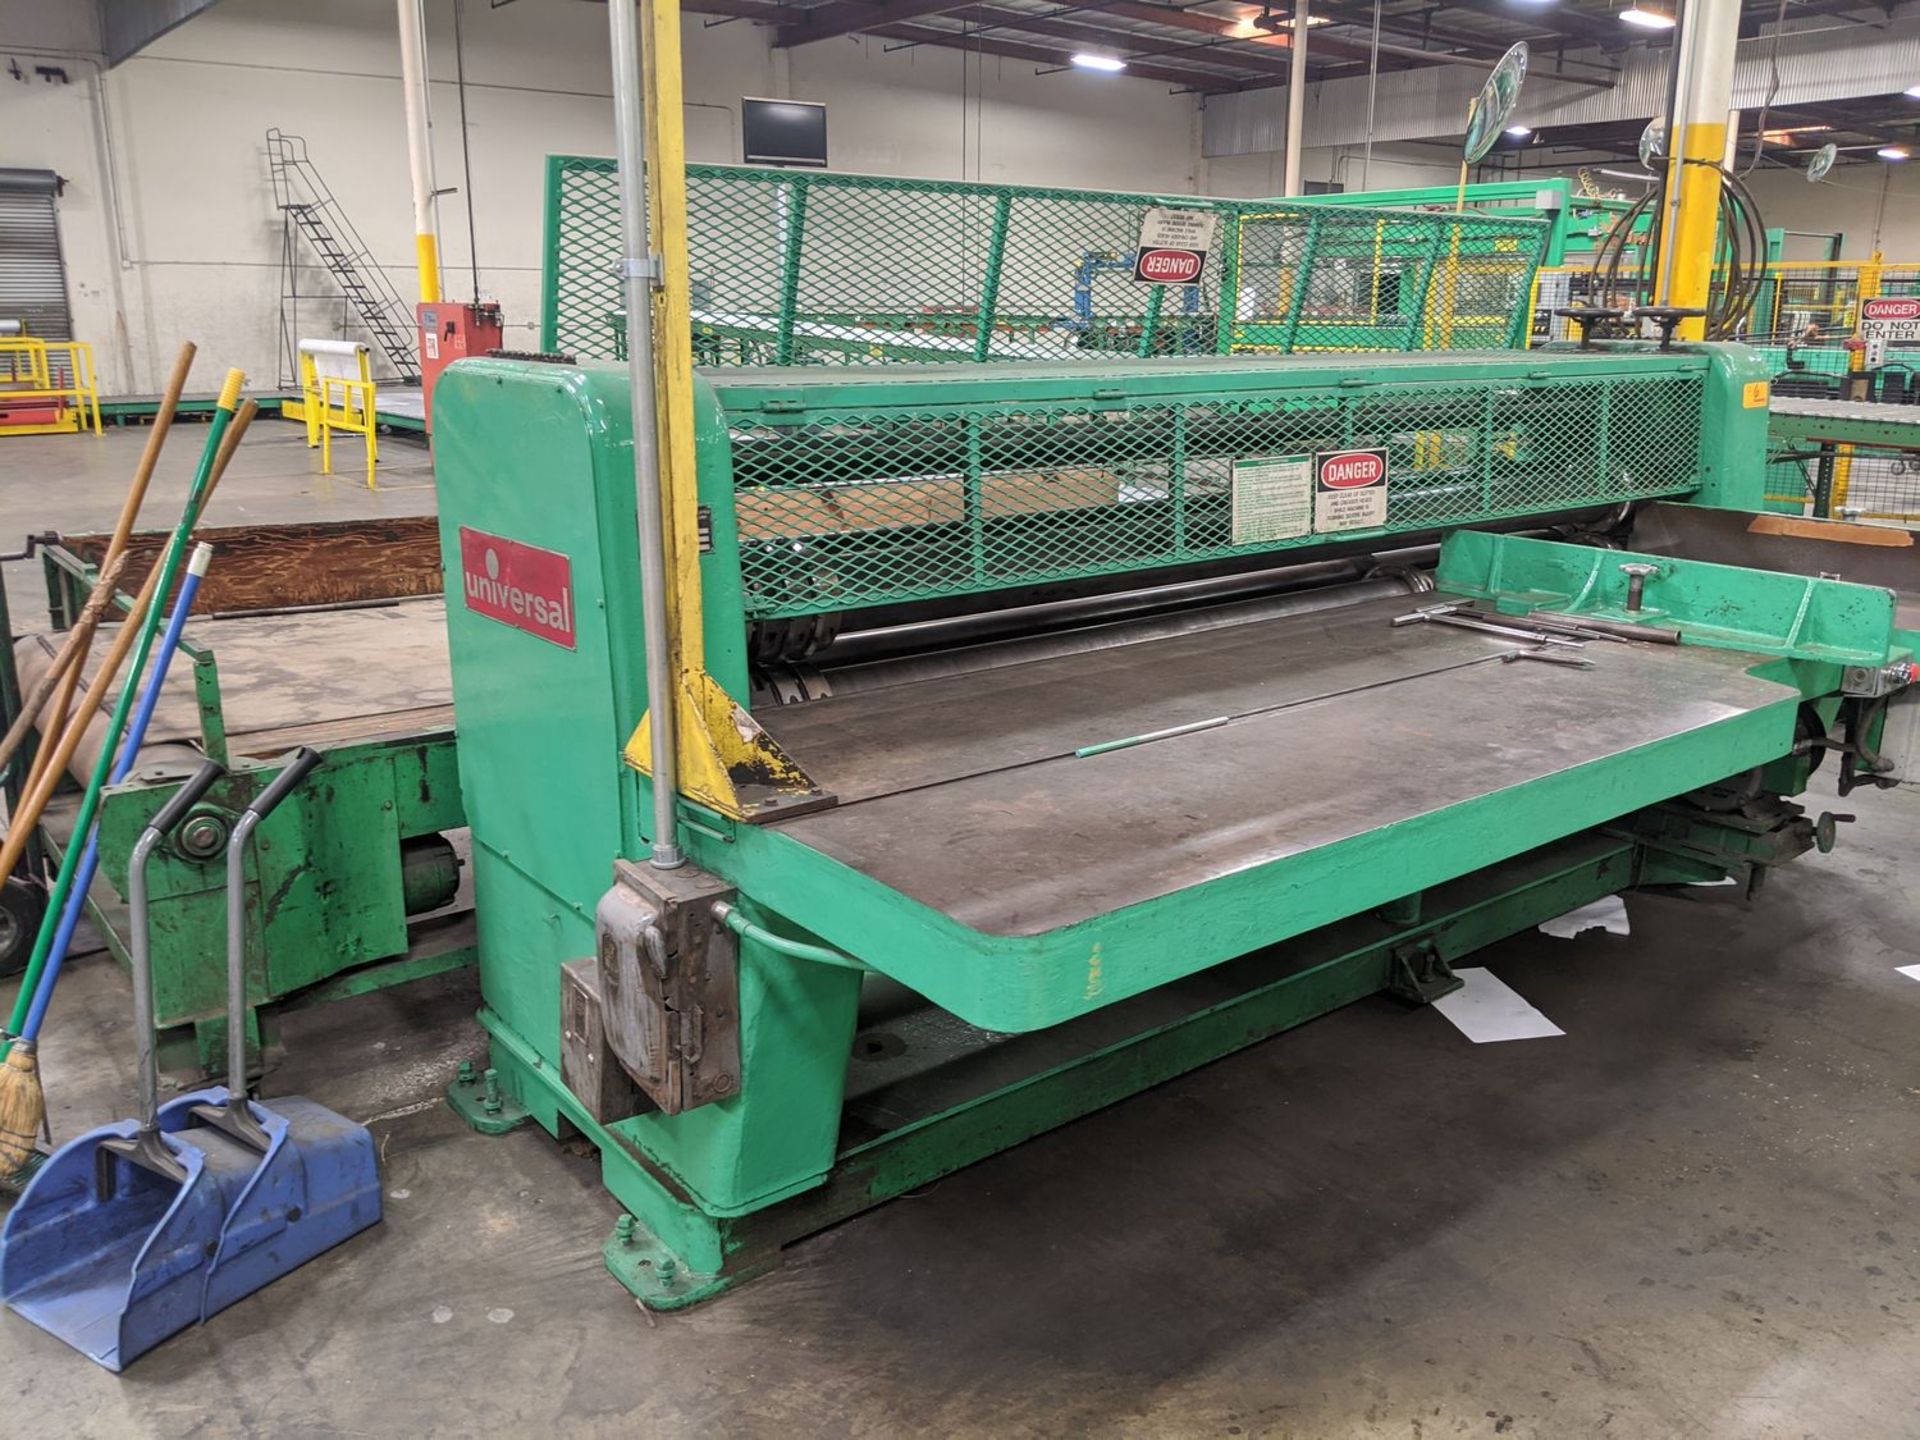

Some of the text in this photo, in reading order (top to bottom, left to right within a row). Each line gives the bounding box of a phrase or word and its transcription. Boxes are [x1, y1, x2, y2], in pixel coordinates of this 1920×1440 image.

[1147, 256, 1196, 274] DANGER
[1868, 303, 1918, 315] DANGER
[1861, 321, 1920, 331] DO NOT
[1865, 331, 1915, 340] ENTER
[1328, 462, 1377, 482] DANGER
[465, 548, 570, 632] universal
